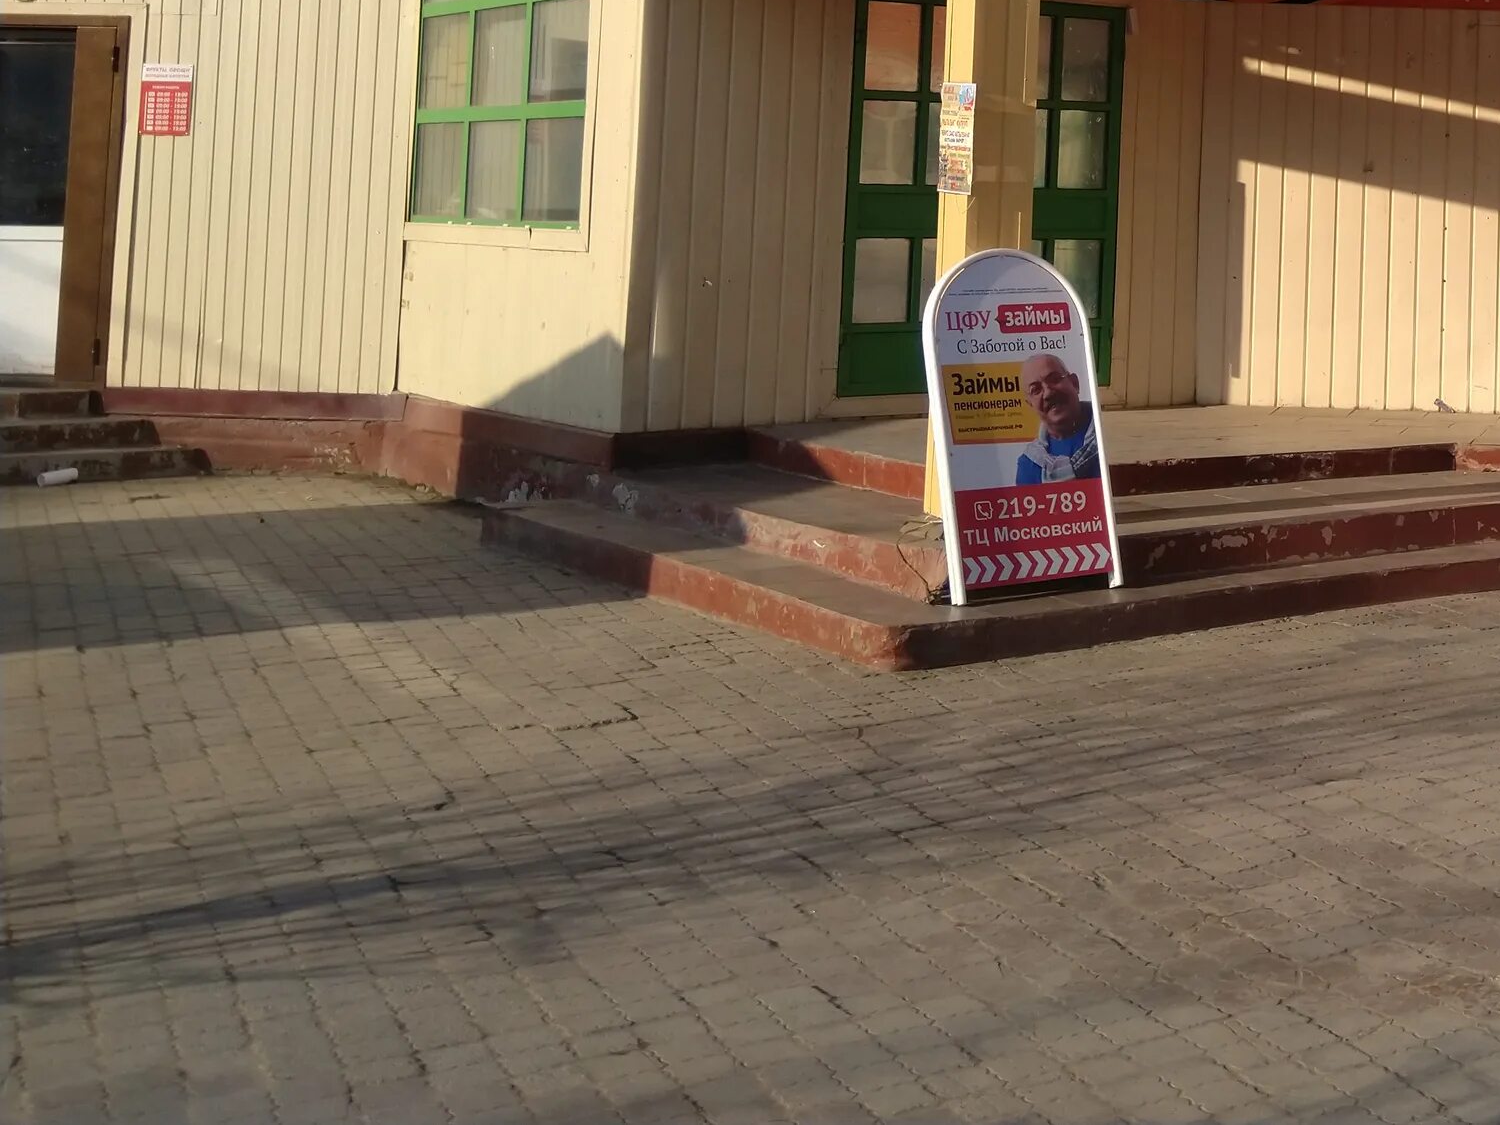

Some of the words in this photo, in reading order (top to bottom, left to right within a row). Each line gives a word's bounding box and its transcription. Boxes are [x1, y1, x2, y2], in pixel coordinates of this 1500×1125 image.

[945, 310, 991, 334] ЦФУ
[1004, 305, 1066, 327] займы
[957, 339, 968, 354] С
[971, 338, 1025, 354] Заботой
[1028, 340, 1037, 351] о
[1040, 335, 1067, 351] Вас!
[951, 372, 1020, 396] Займы
[954, 398, 1022, 412] пенсионерам
[997, 490, 1087, 520] 219-789
[963, 528, 990, 546] ТЦ
[994, 516, 1103, 543] Московский
